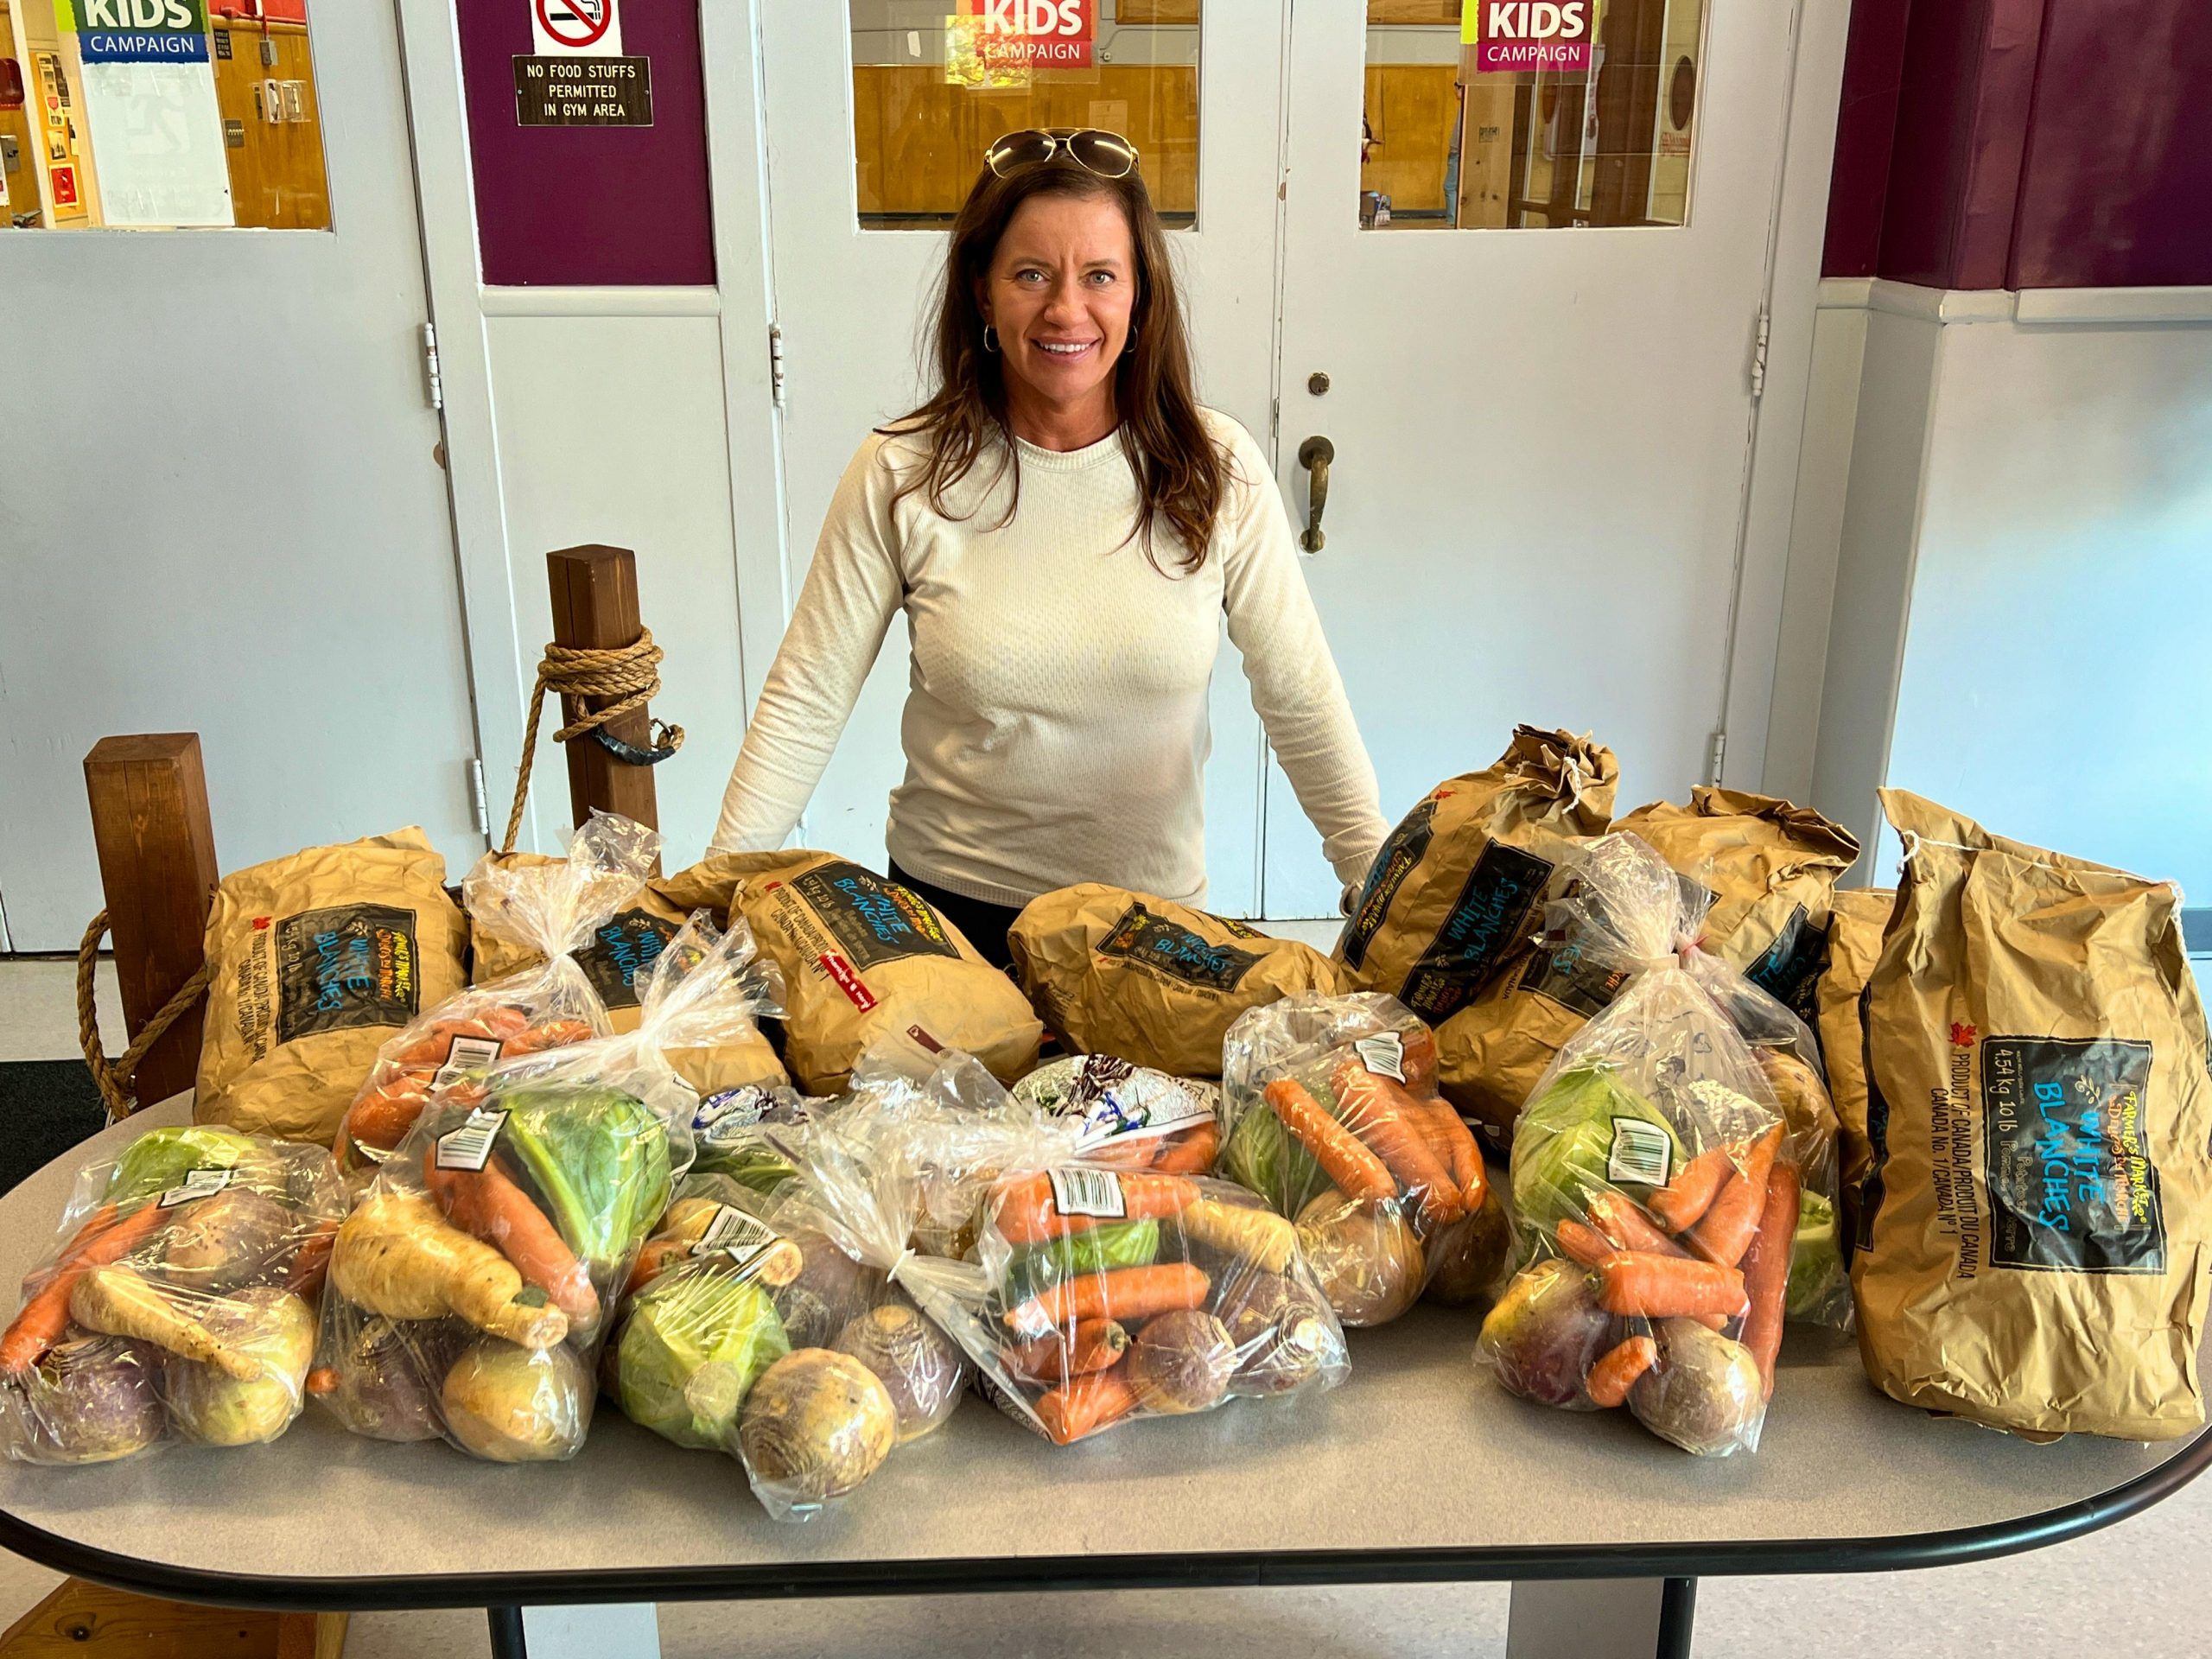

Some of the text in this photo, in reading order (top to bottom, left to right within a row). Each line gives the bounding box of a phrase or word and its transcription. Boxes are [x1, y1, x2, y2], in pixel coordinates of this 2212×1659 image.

[84, 0, 192, 29] KIDS
[984, 0, 1082, 35] KIDS
[1488, 2, 1585, 38] KIDS
[91, 36, 194, 53] CAMPAIGN
[985, 43, 1080, 59] CAMPAIGN
[1487, 46, 1580, 61] CAMPAIGN
[527, 65, 636, 78] NO FOOD STUFFS
[549, 85, 617, 98] PERMITTED
[544, 103, 625, 117] IN GYM AREA
[834, 878, 899, 944] BLANCHES
[869, 893, 912, 934] WHITE
[1447, 886, 1488, 941] WHITE
[1464, 877, 1518, 962] BLANCHES
[282, 938, 300, 951] kg
[347, 938, 372, 990] WHITE
[253, 961, 267, 971] OF
[314, 931, 342, 1012] BLANCHES
[1930, 1088, 1949, 1134] CANADA
[1989, 1049, 2018, 1132] 4.54 kg 10 lb
[1932, 1136, 1949, 1154] No.
[2034, 1082, 2071, 1231] BLANCHES
[2074, 1109, 2107, 1205] WHITE
[2121, 1091, 2150, 1207] FARMER'S MARKET
[1932, 1158, 1955, 1212] 1/CANADA
[1951, 1053, 1980, 1279] PRODUCT OF CANADA/PRODUIT DU CANADA
